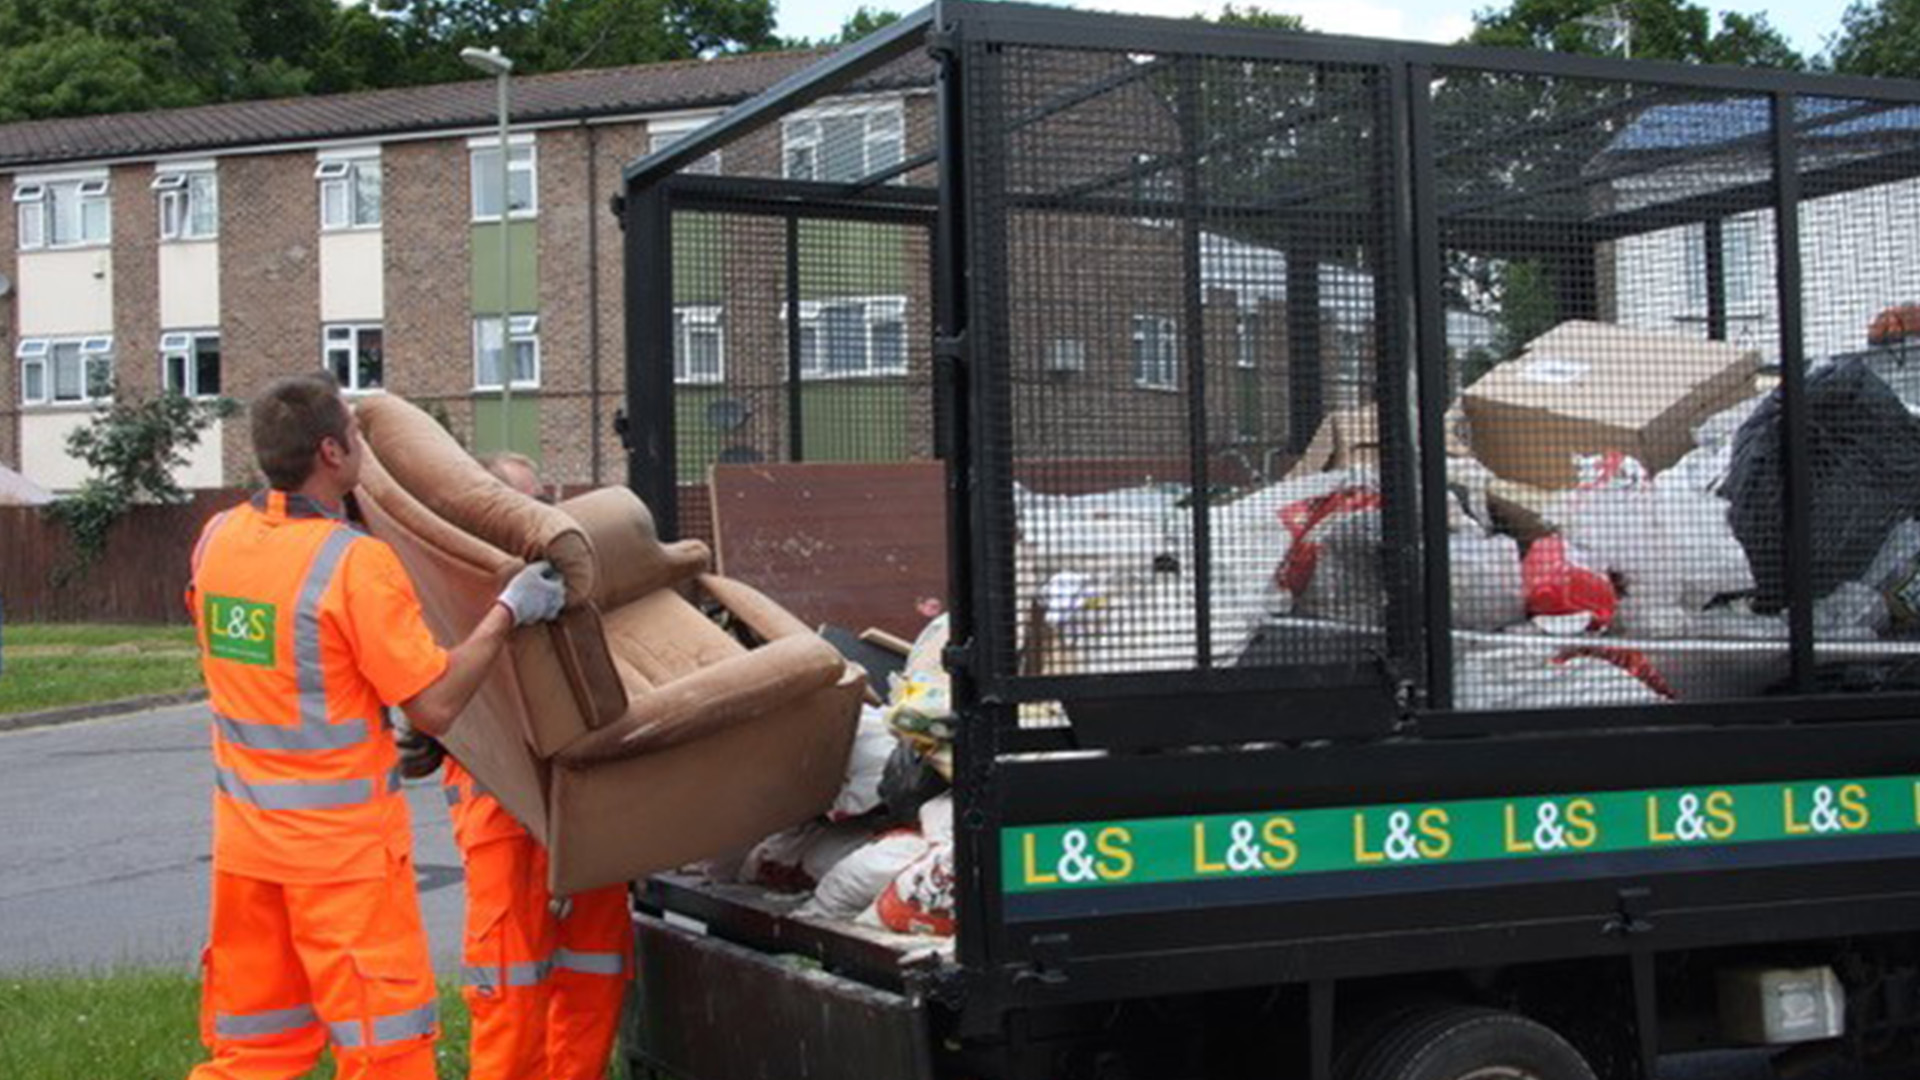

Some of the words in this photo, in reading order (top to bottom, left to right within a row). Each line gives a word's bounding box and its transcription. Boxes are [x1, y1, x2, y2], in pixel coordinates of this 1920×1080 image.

[211, 602, 266, 642] L&S
[1023, 827, 1133, 884] L&S
[1193, 817, 1297, 873] L&S
[1354, 808, 1451, 863] L&S
[1505, 799, 1597, 852] L&S
[1647, 791, 1736, 841] L&S
[1783, 784, 1869, 833] L&S
